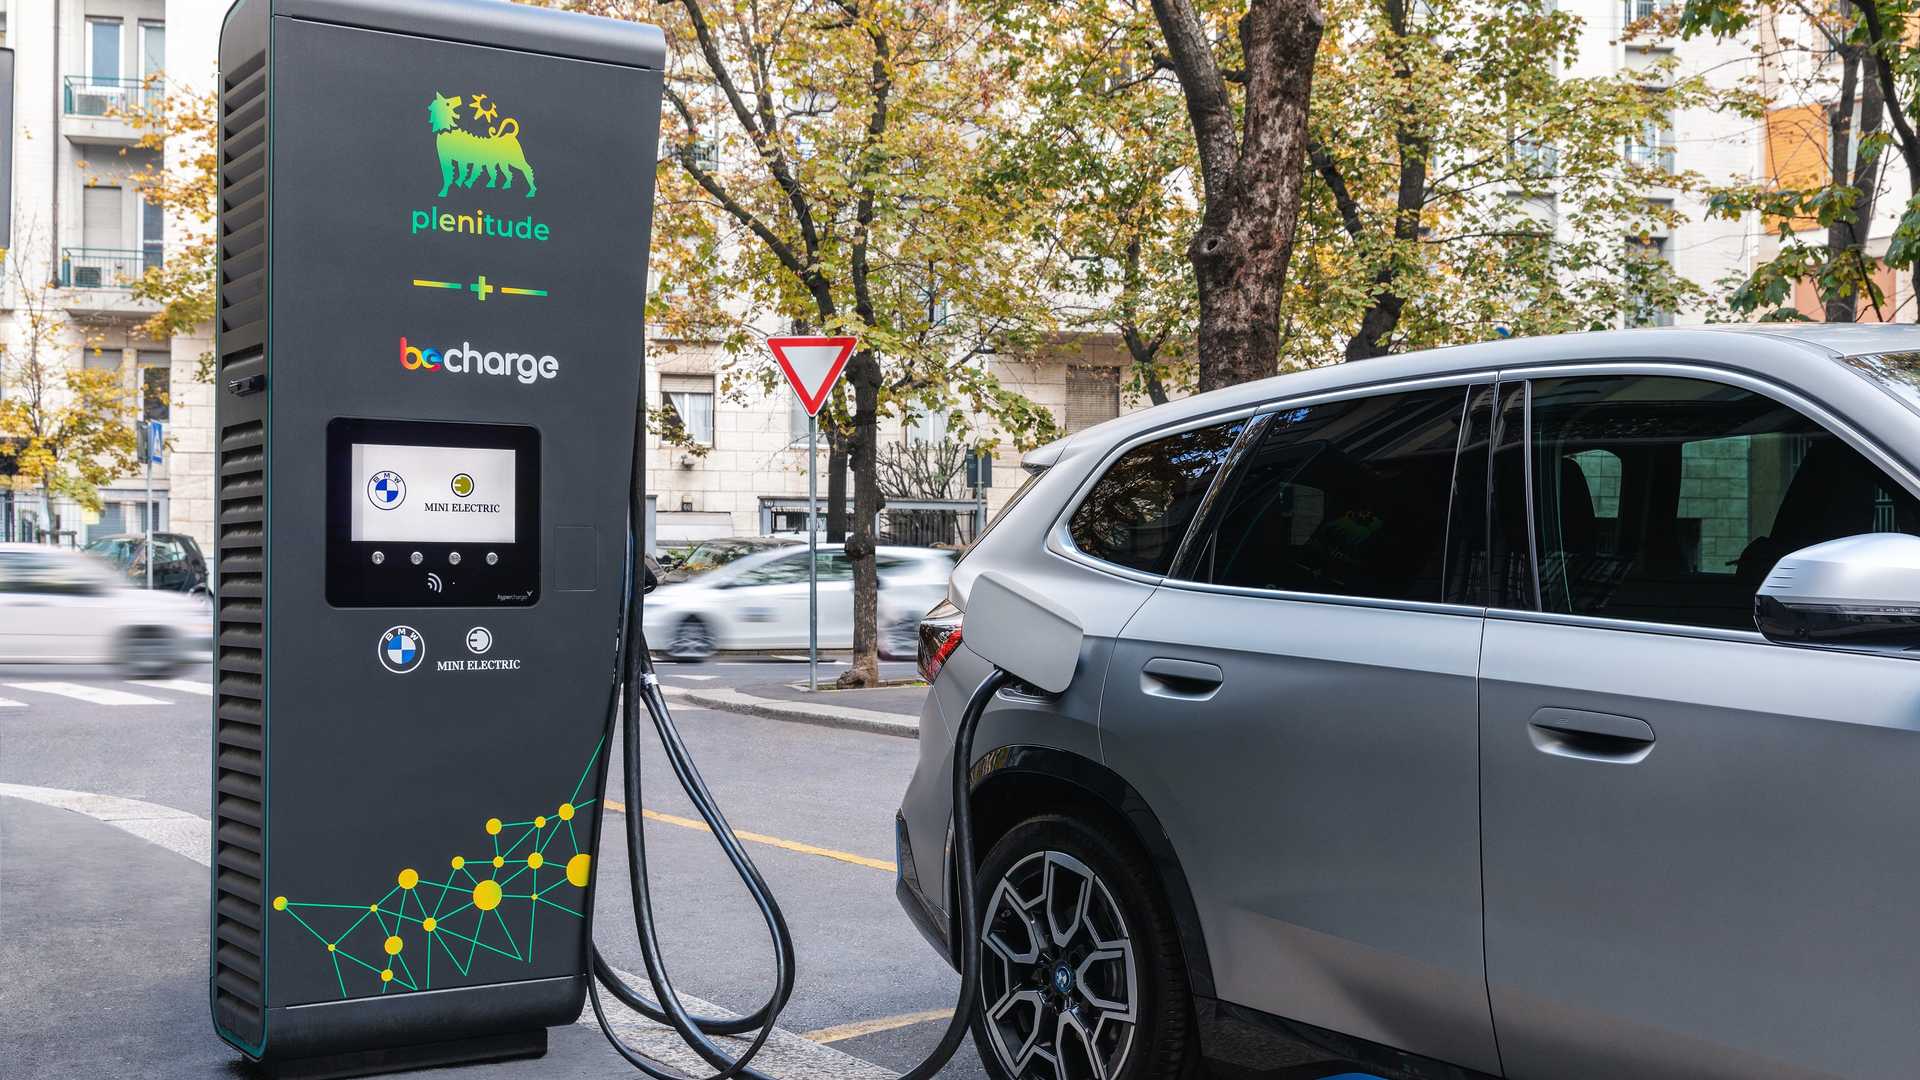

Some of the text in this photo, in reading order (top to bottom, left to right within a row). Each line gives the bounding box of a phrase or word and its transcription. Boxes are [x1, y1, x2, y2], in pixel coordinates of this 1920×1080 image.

[411, 206, 550, 241] plenitude
[399, 336, 559, 384] becharge
[424, 502, 500, 513] MINI ELECTRIC
[437, 659, 520, 671] MINI ELECTRIC
